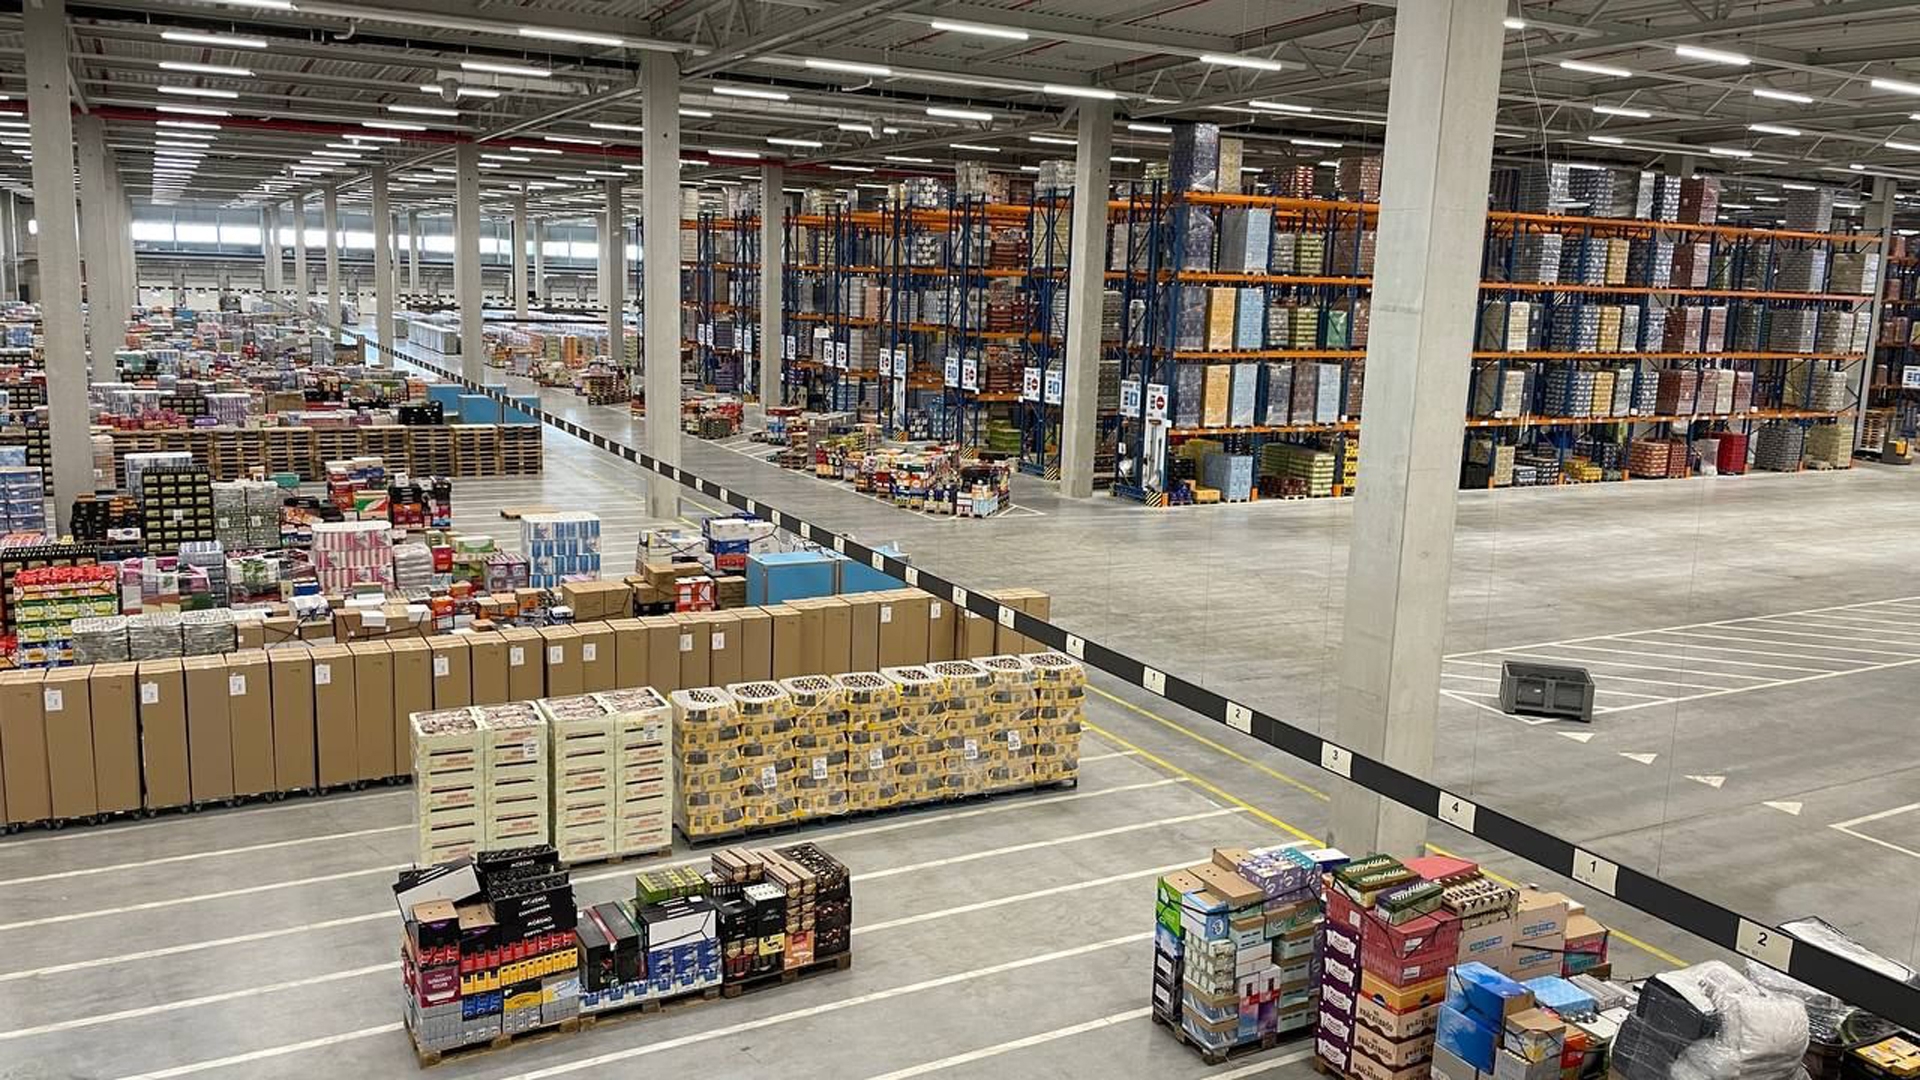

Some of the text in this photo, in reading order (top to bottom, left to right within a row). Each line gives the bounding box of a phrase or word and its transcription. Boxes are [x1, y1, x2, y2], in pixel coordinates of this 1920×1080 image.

[1235, 708, 1241, 719] 2
[1332, 749, 1339, 761] 3
[1451, 801, 1459, 813] 4
[1590, 860, 1597, 873] 1
[1757, 931, 1768, 947] 2
